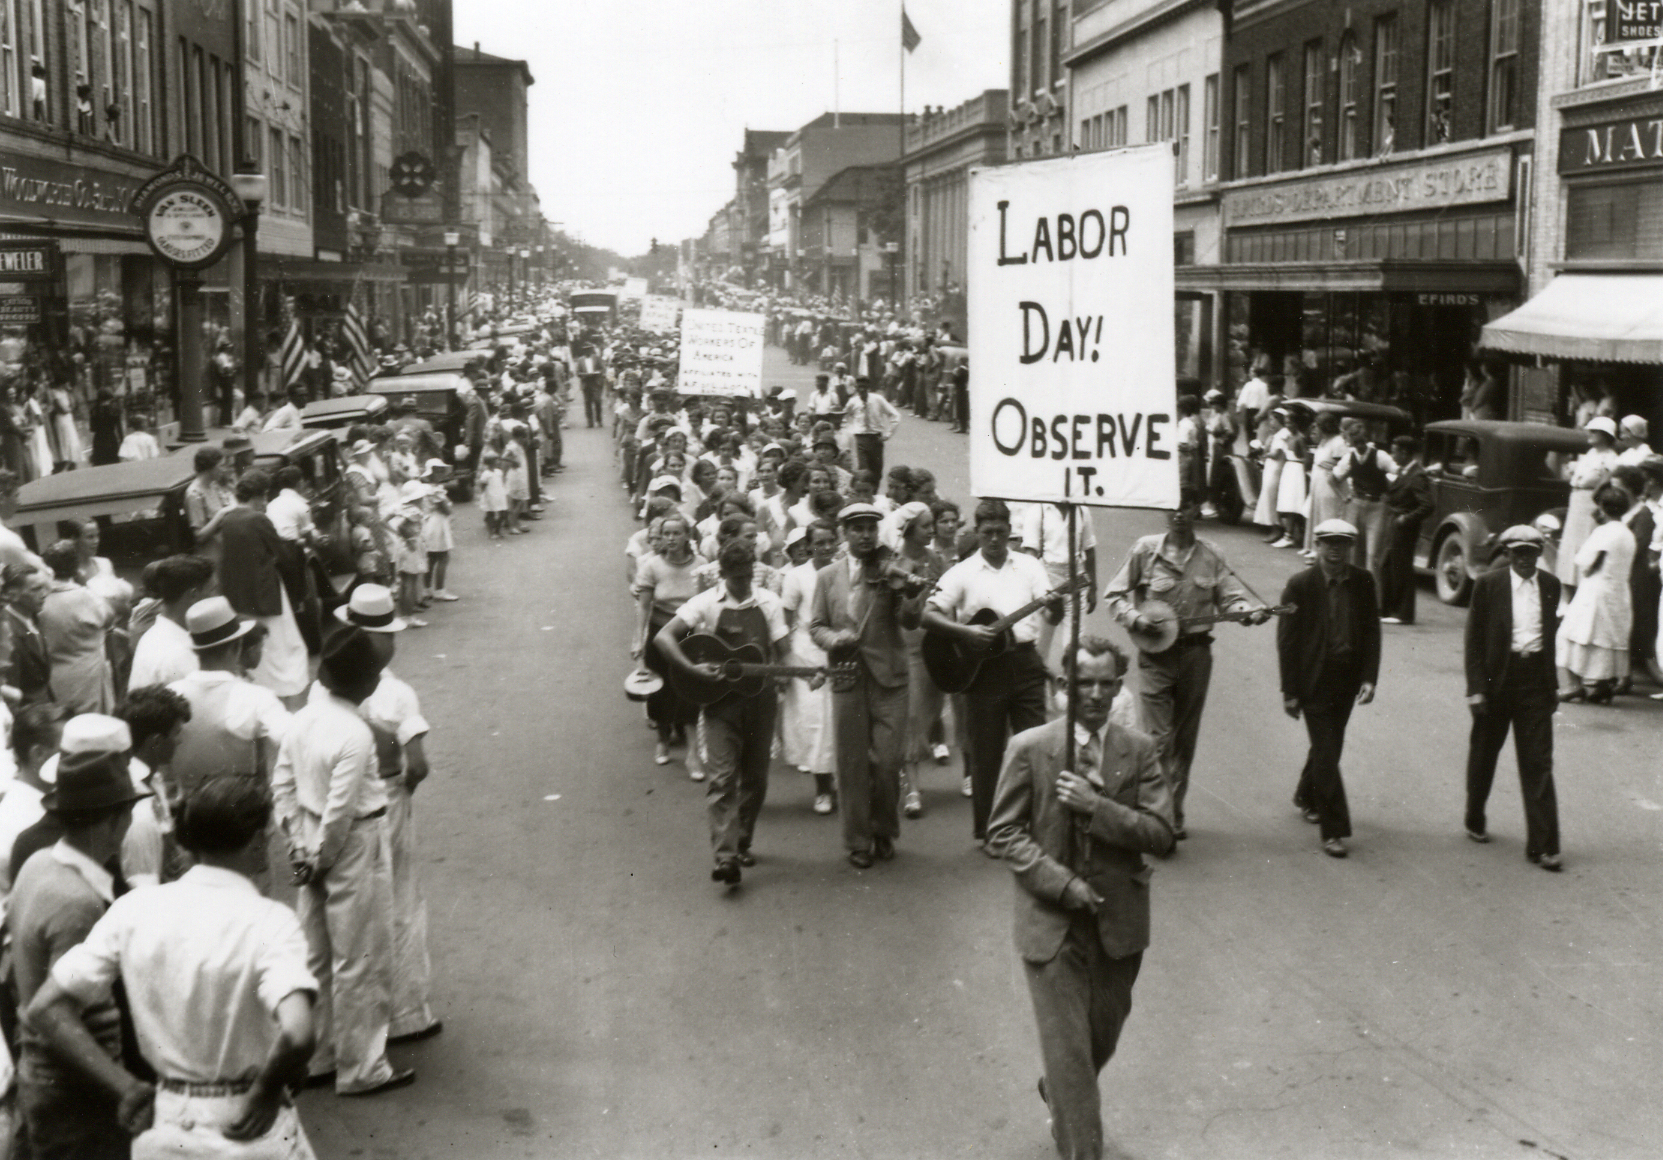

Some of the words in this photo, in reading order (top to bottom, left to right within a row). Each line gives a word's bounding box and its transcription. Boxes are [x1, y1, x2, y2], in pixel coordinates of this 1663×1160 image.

[1621, 25, 1661, 37] SHOES
[133, 170, 183, 208] DIAMONDS
[1424, 163, 1498, 198] STORE
[155, 198, 175, 217] VAN
[180, 195, 215, 217] SLEEN
[997, 200, 1130, 266] LABOR
[688, 334, 735, 347] WORKERS
[738, 337, 756, 348] OF
[1019, 301, 1104, 364] DAY!
[693, 350, 734, 361] AMERICA
[991, 397, 1171, 460] OBSERVE
[1065, 466, 1105, 497] IT.
